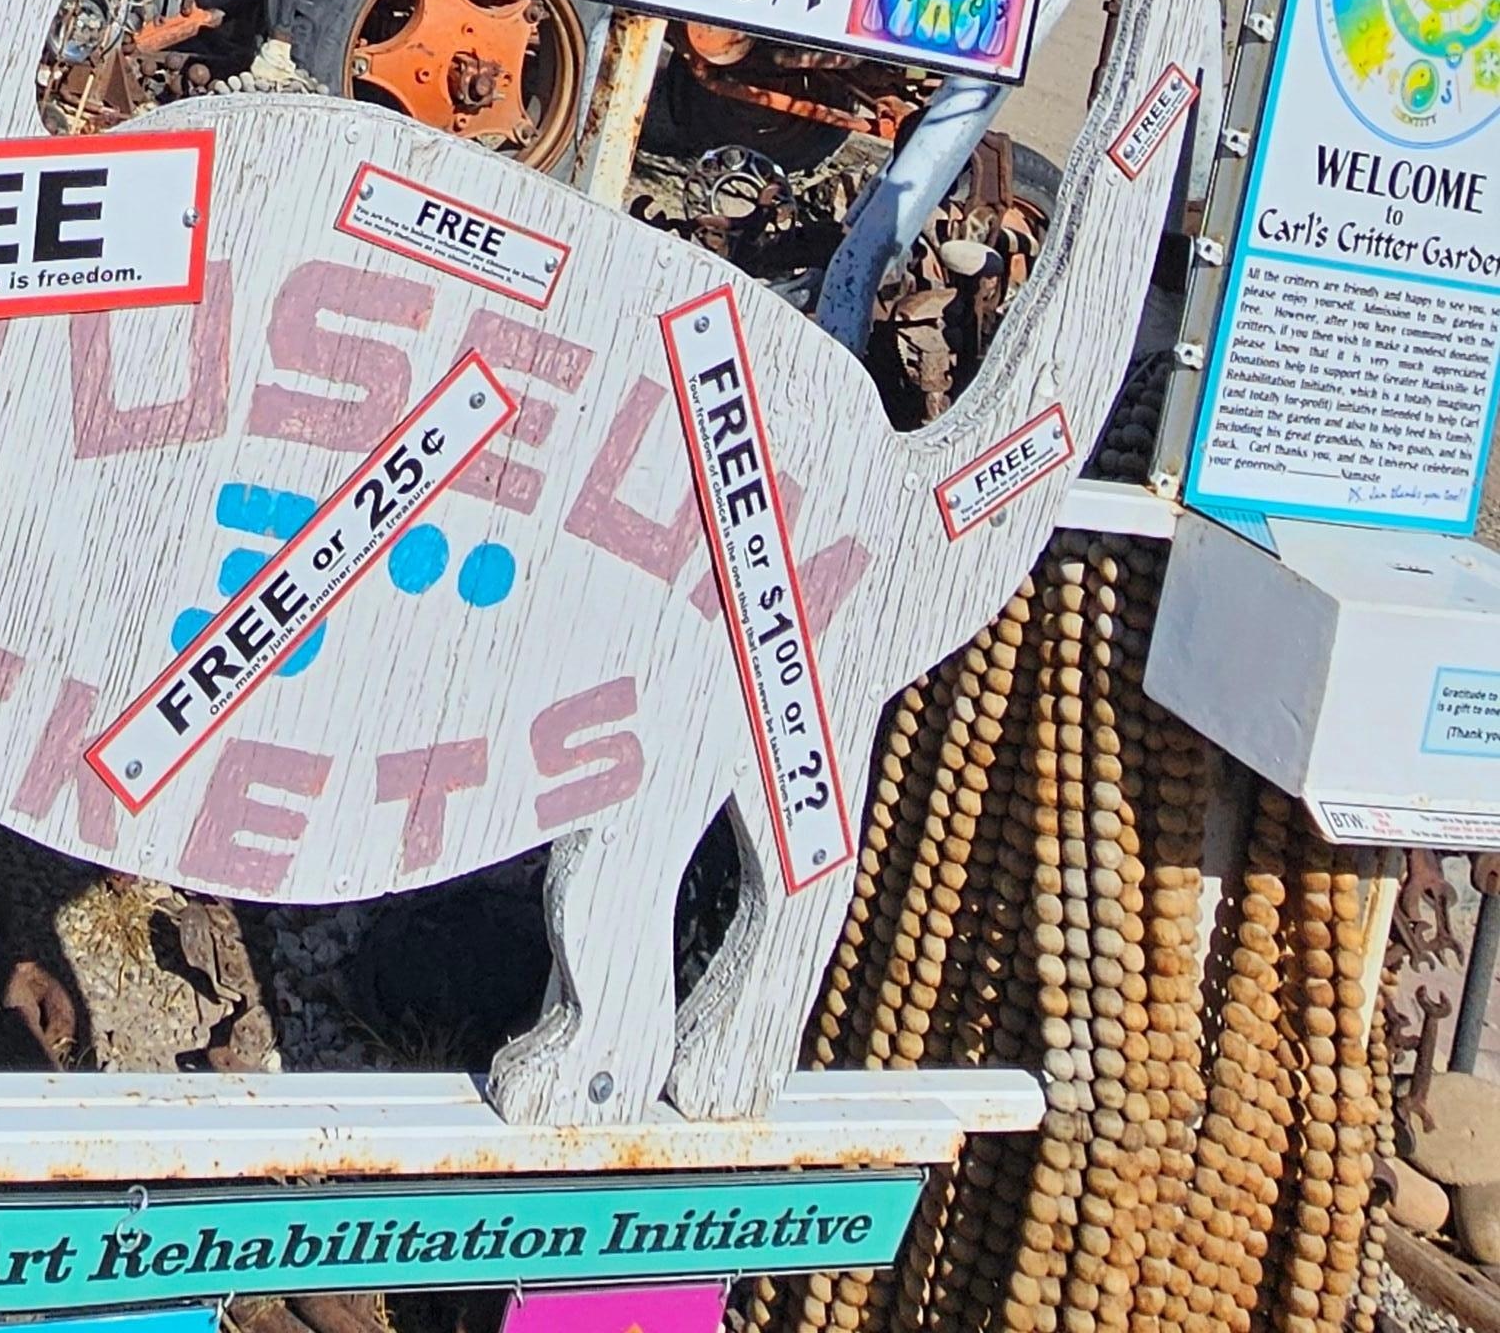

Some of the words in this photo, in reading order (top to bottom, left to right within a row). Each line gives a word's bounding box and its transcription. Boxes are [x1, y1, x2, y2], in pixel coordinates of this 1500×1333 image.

[1132, 91, 1170, 143] FREE
[1317, 144, 1488, 214] WELCOME
[417, 201, 504, 255] FREE
[1385, 204, 1404, 226] to
[1257, 208, 1329, 248] Carl's
[1337, 221, 1418, 262] Critter
[9, 270, 29, 291] is
[37, 265, 143, 288] freedom.
[688, 374, 700, 403] Your
[695, 407, 712, 461] freedom
[700, 360, 765, 524] FREE
[708, 464, 718, 477] of
[975, 438, 1035, 492] FREE
[712, 481, 726, 523] choice
[722, 525, 730, 538] is
[726, 540, 735, 561] the
[743, 534, 769, 567] or
[158, 572, 306, 732] FREE
[312, 529, 345, 570] or
[354, 428, 443, 529] 25¢
[731, 565, 741, 588] one
[209, 691, 233, 715] One
[235, 654, 268, 689] man's
[268, 626, 294, 655] junk
[295, 613, 307, 625] is
[309, 565, 350, 611] another
[352, 530, 384, 565] man's
[385, 479, 435, 528] treasure.
[737, 591, 749, 624] thing
[745, 626, 757, 652] that
[752, 655, 762, 678] can
[757, 681, 770, 714] never
[1443, 686, 1486, 700] Gratitude
[1454, 703, 1471, 716] gift
[765, 717, 773, 733] be
[780, 701, 805, 734] or
[769, 736, 781, 771] taken
[777, 773, 788, 802] from
[788, 750, 828, 812] ??
[98, 1213, 585, 1280] Rehabilitation
[597, 1207, 873, 1255] Initiative
